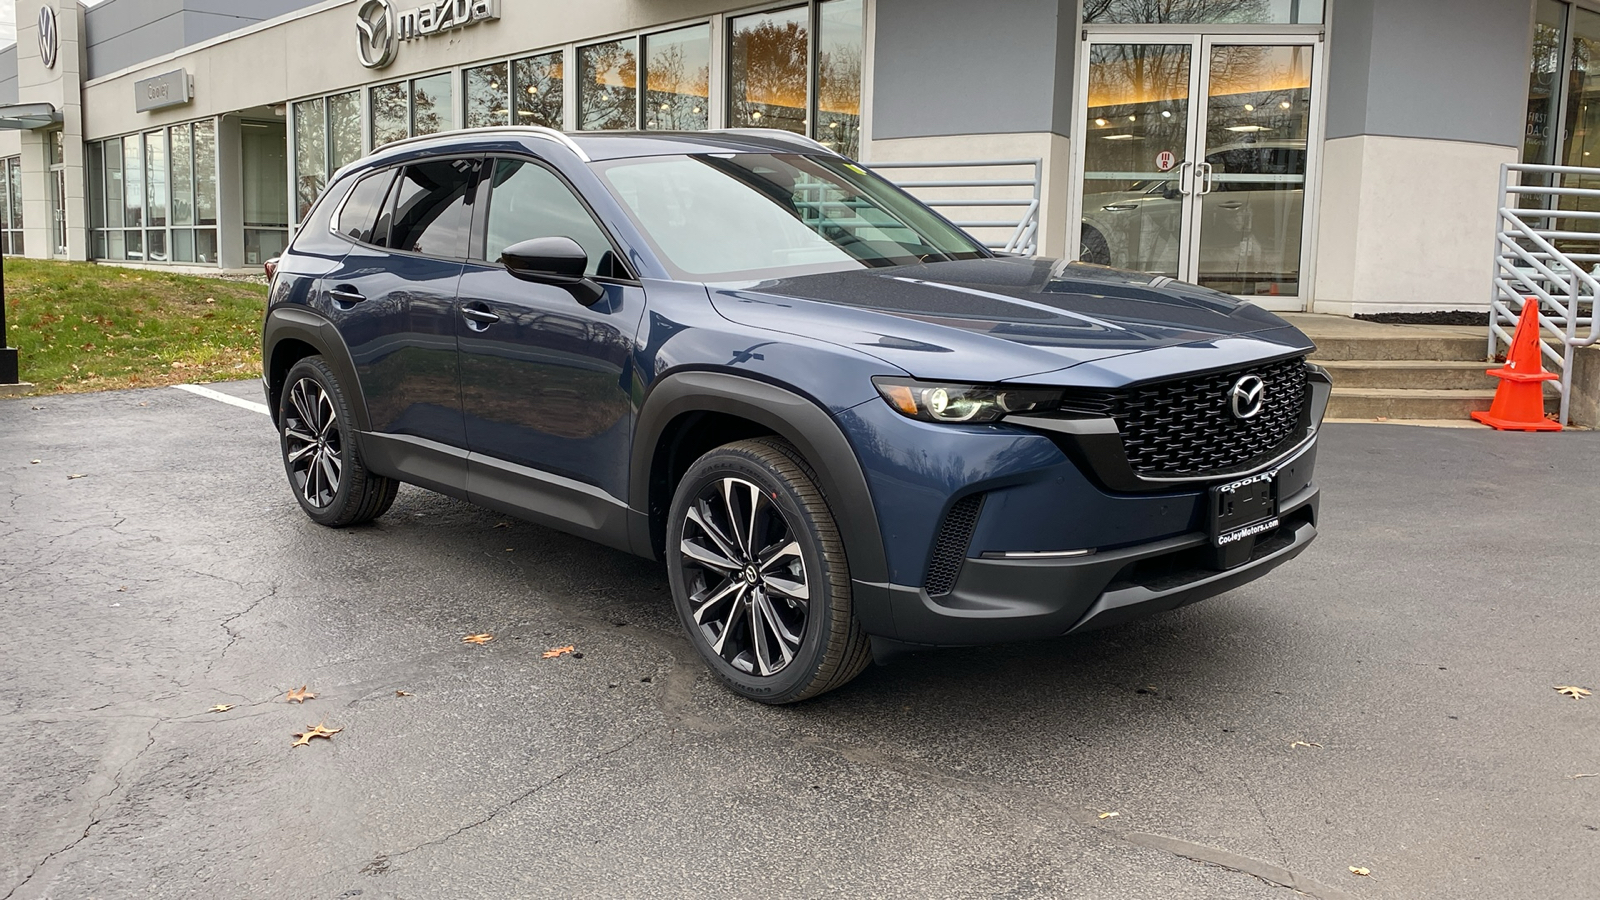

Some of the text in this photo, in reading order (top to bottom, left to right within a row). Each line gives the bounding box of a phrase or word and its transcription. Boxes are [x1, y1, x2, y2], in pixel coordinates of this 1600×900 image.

[397, 0, 494, 41] mazda
[1528, 111, 1547, 123] FIRST
[1162, 160, 1169, 169] R
[1220, 469, 1279, 493] COOLEY
[1218, 518, 1279, 545] CooleyMotors.com
